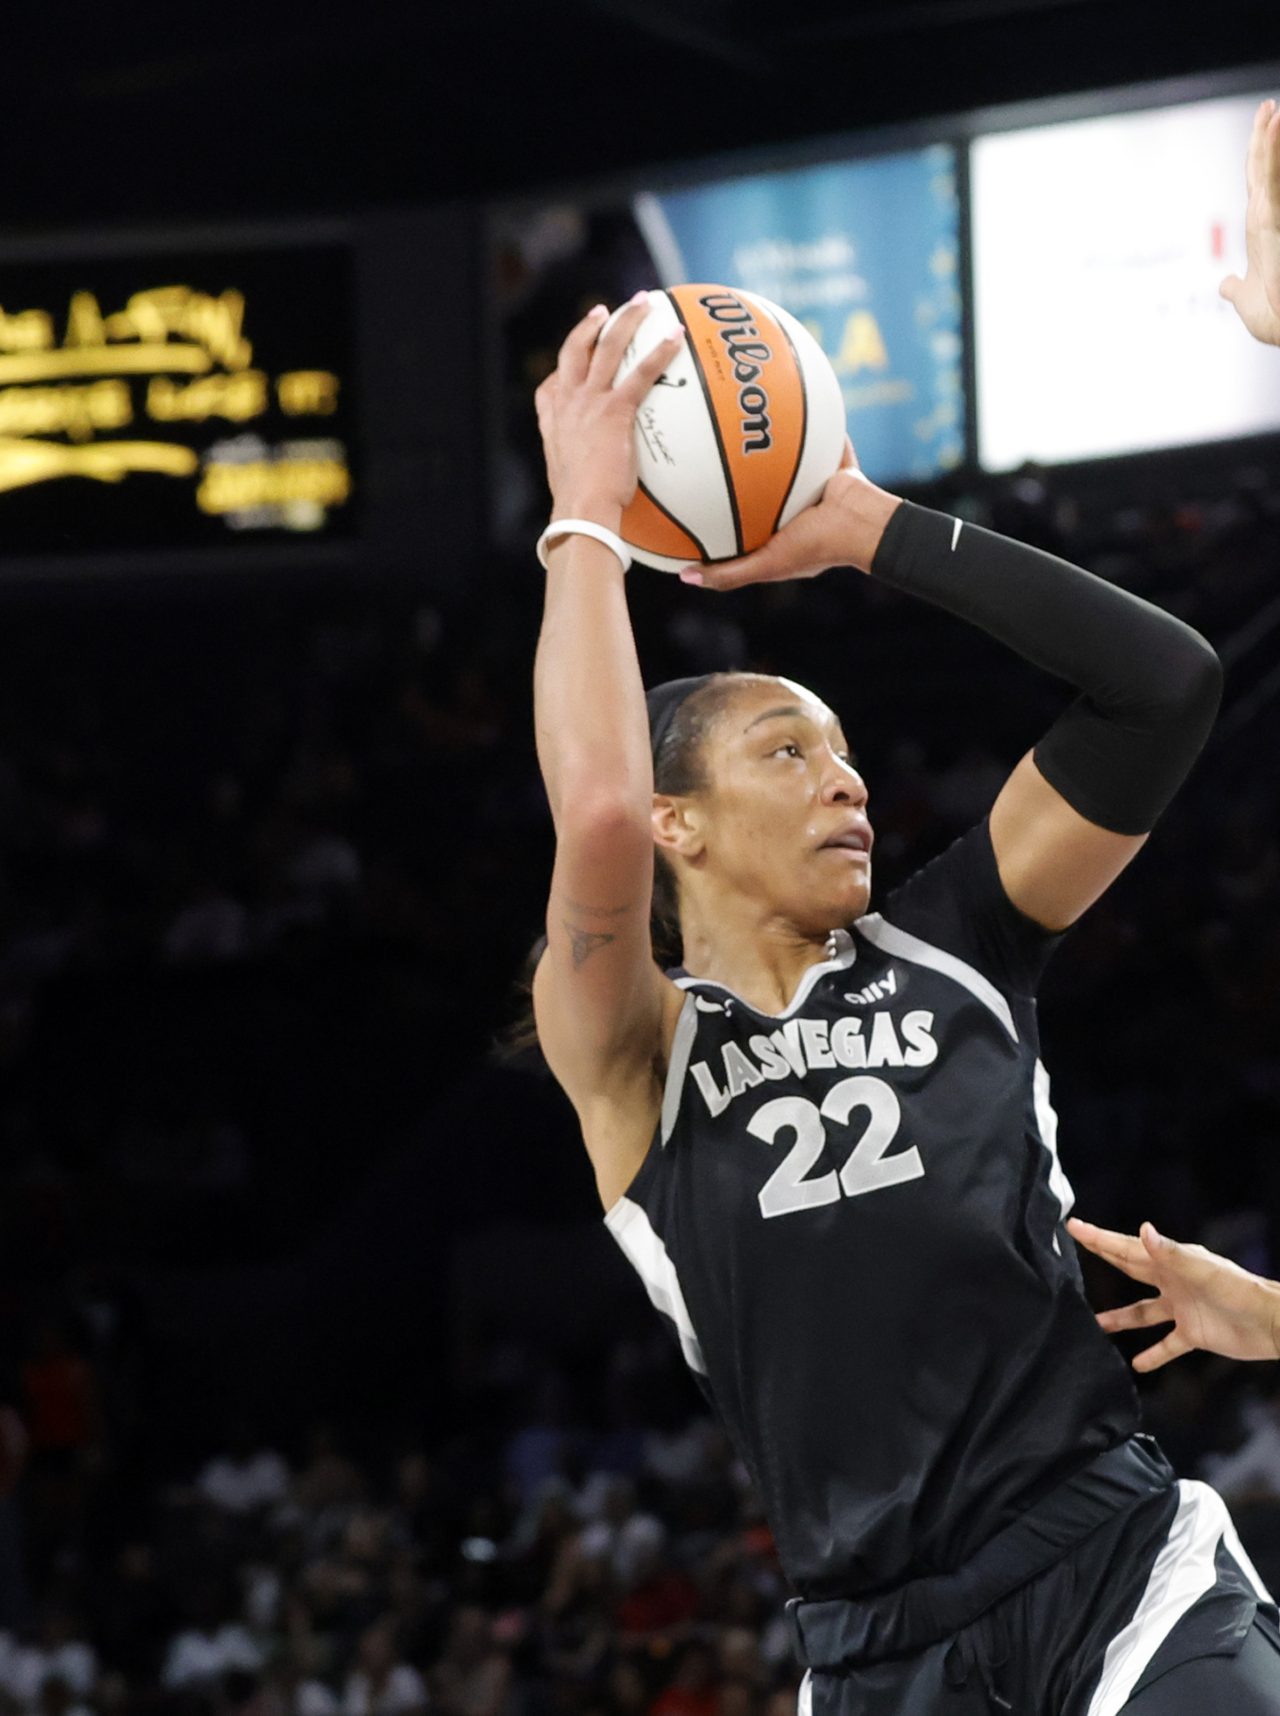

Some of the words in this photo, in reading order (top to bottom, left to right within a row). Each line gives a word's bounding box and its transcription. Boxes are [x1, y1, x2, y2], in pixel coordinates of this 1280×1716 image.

[698, 292, 772, 454] Wilson
[843, 968, 897, 1006] ally
[745, 1075, 925, 1220] 22
